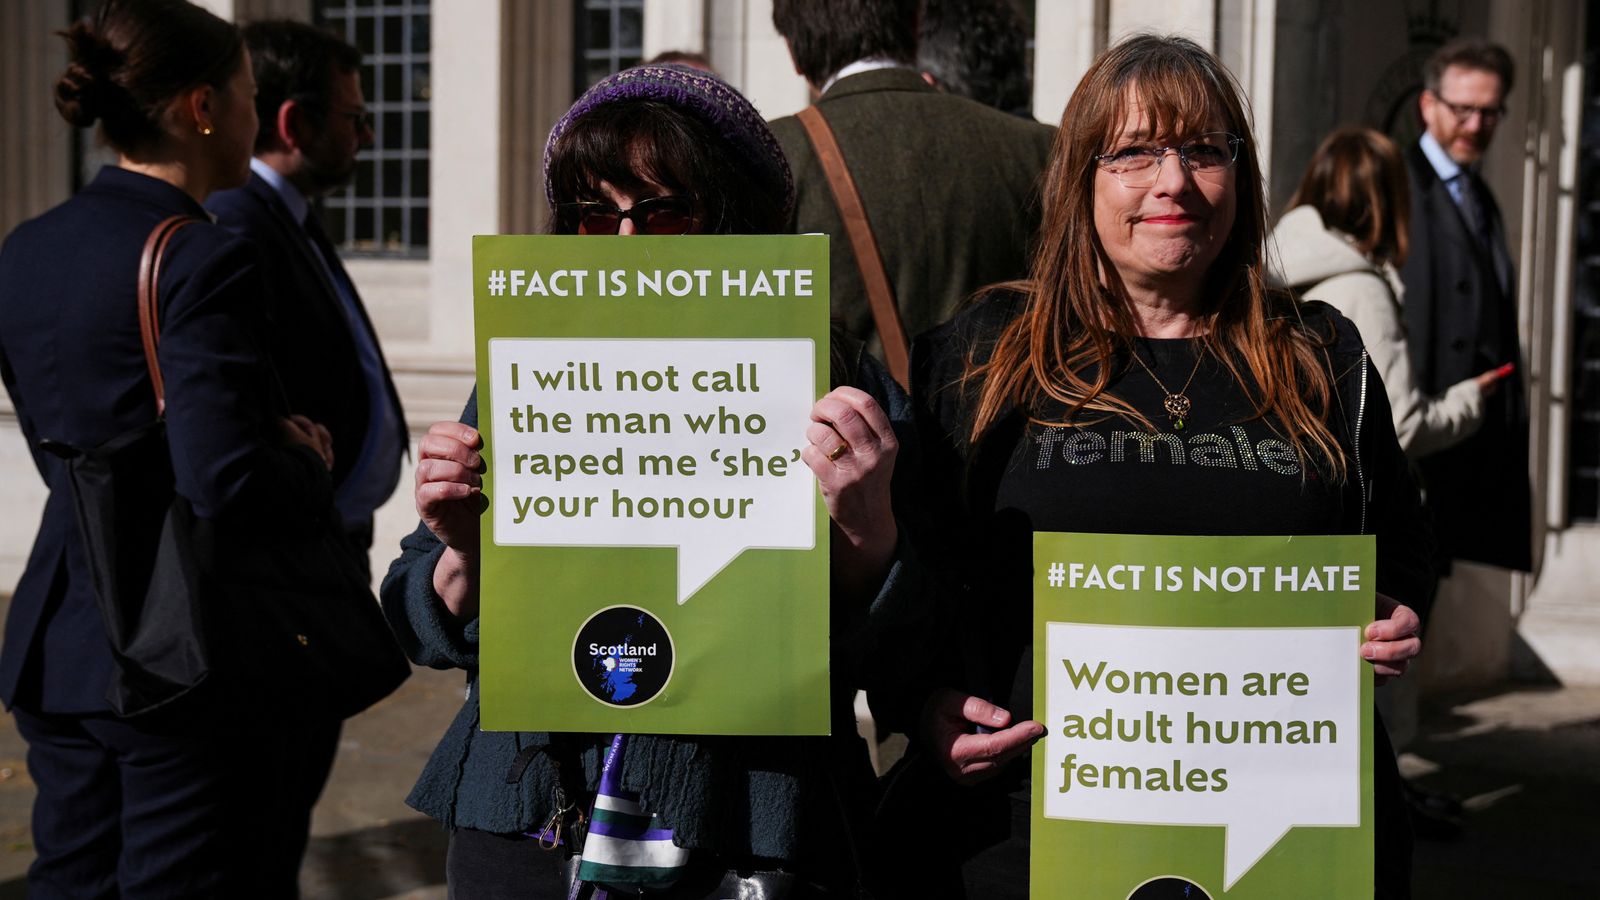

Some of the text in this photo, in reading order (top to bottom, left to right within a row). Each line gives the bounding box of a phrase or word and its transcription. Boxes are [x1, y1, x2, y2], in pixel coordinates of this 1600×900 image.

[488, 269, 813, 297] #FACT IS NOT HATE
[511, 361, 760, 393] I will not call
[509, 404, 767, 435] the man who
[513, 447, 624, 482] raped
[638, 454, 697, 477] me
[512, 488, 754, 525] your honour
[1047, 562, 1360, 593] #FACT IS NOT HATE
[589, 643, 657, 656] Scotland
[1062, 659, 1310, 697] Women are
[1062, 708, 1337, 745] adult human
[1058, 753, 1229, 794] females
